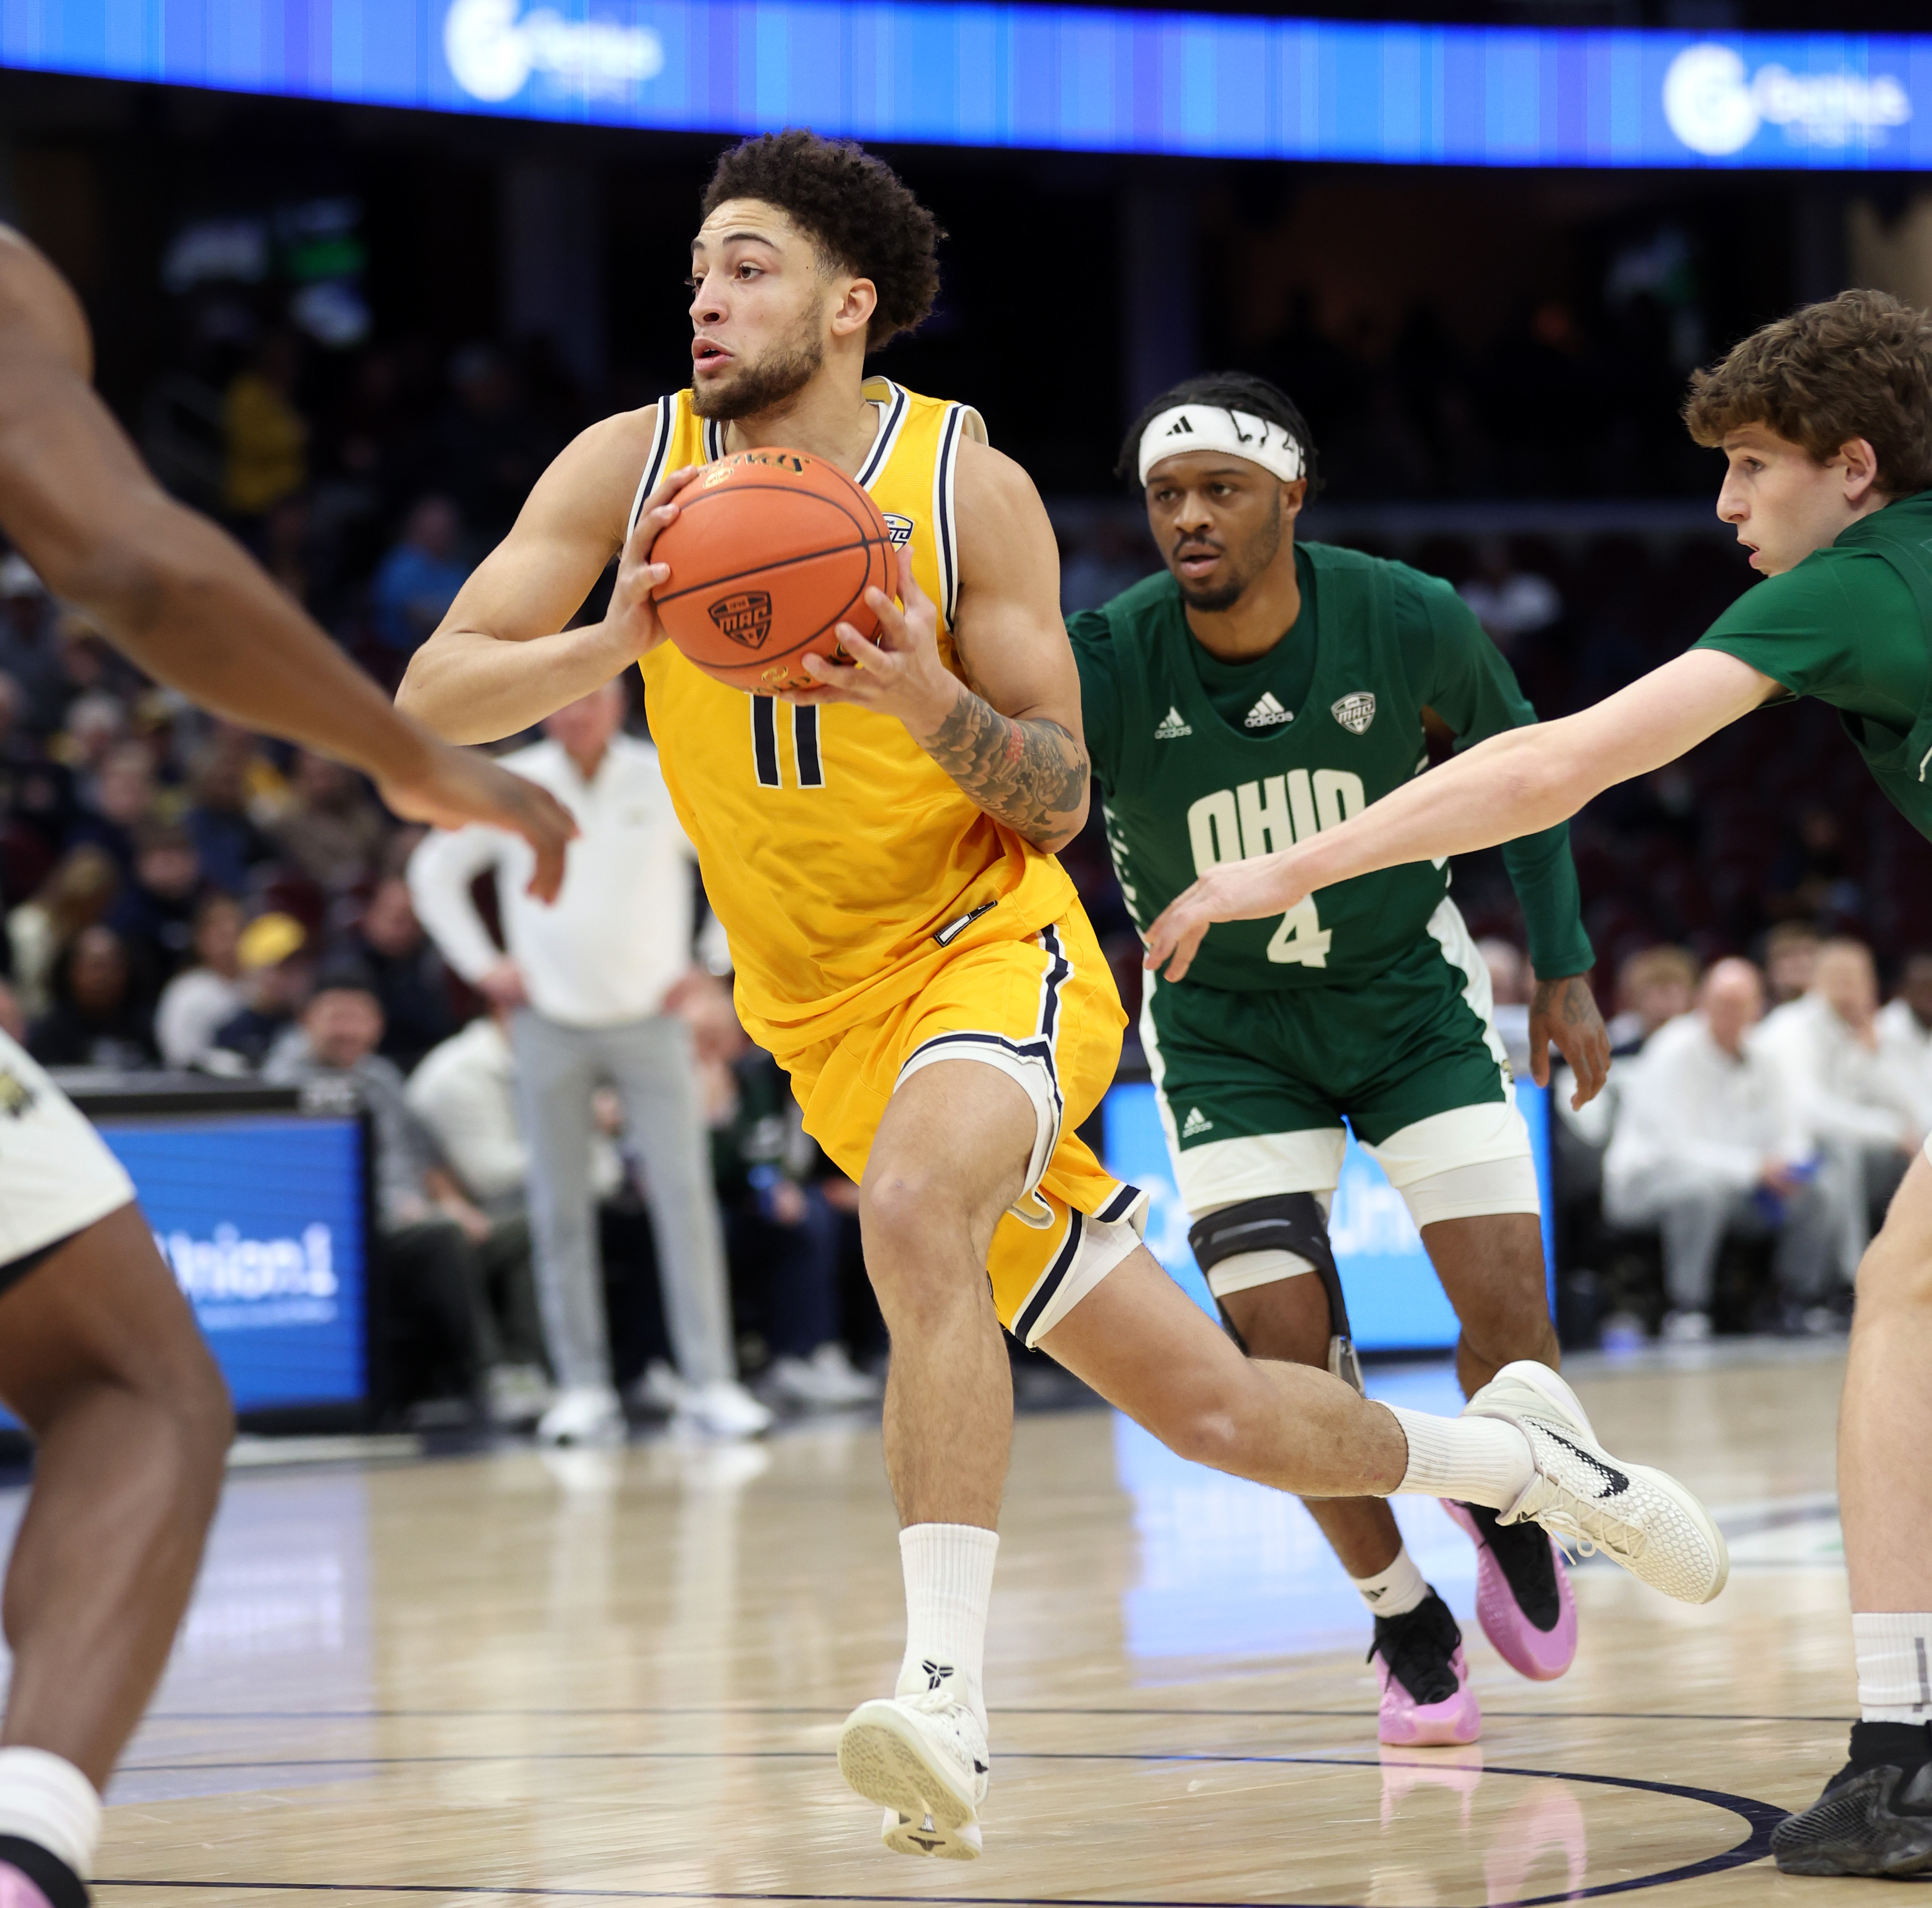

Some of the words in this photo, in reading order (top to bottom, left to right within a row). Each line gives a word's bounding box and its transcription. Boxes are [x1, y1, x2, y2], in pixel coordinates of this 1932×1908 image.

[719, 606, 772, 632] MAC
[1244, 710, 1294, 728] adidas
[1338, 703, 1375, 724] MAC
[744, 690, 826, 790] 11
[1154, 725, 1192, 739] adidas
[1187, 769, 1366, 878] OHIO
[1267, 894, 1332, 968] 4
[1182, 1120, 1213, 1138] adidas
